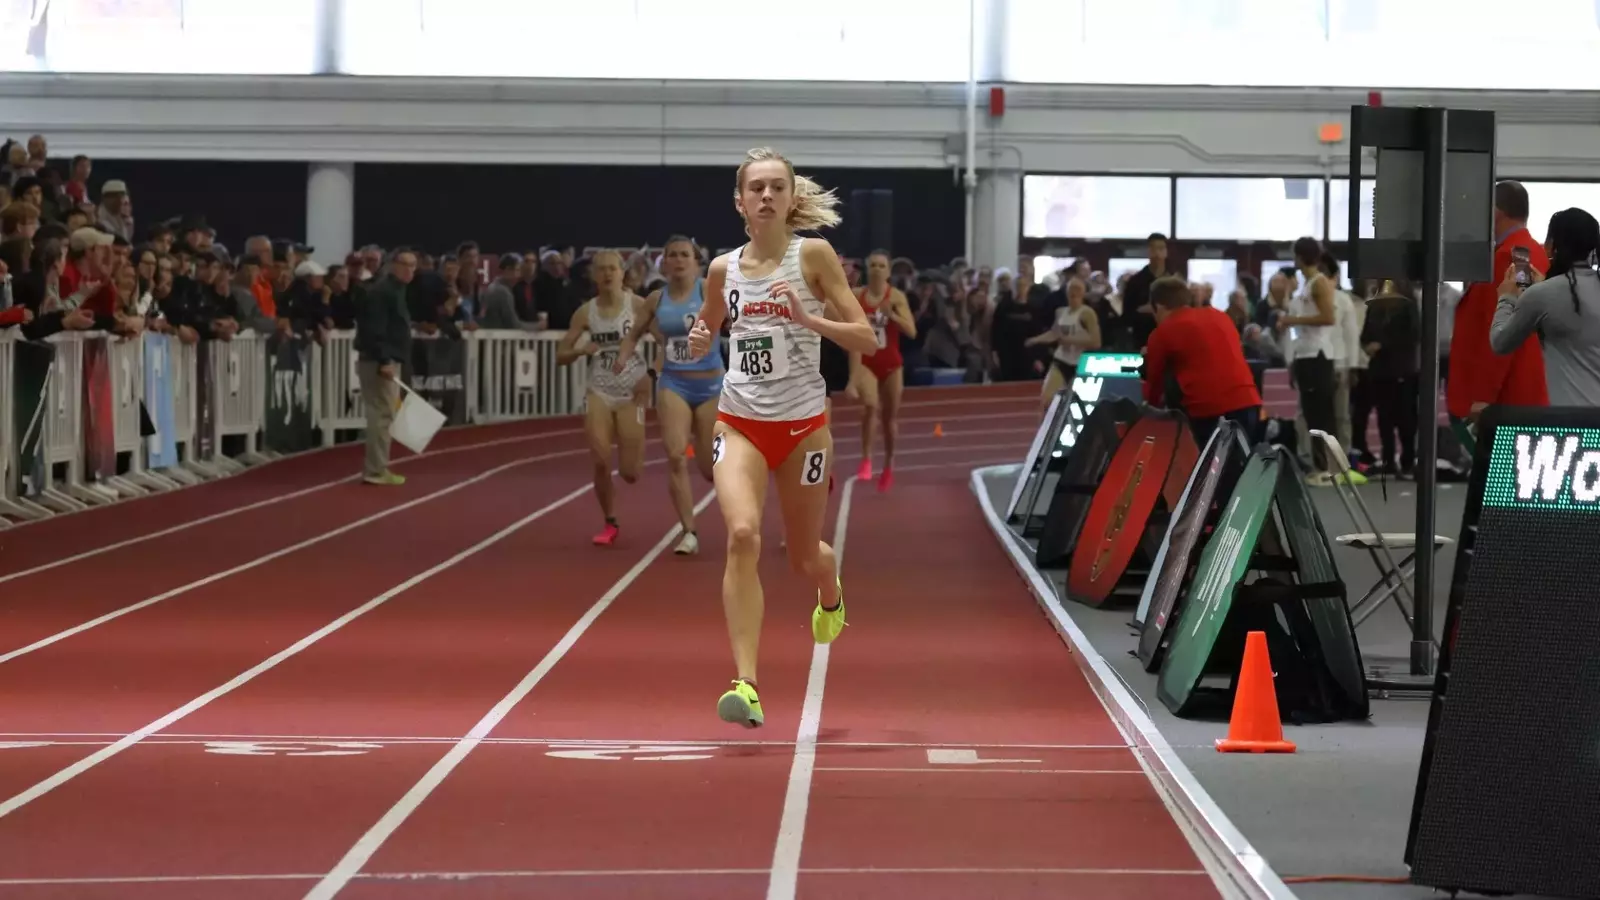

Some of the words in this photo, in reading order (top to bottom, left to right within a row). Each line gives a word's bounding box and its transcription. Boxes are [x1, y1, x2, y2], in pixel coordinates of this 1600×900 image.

[729, 289, 740, 323] 8
[740, 350, 774, 376] 483
[806, 452, 824, 484] 8
